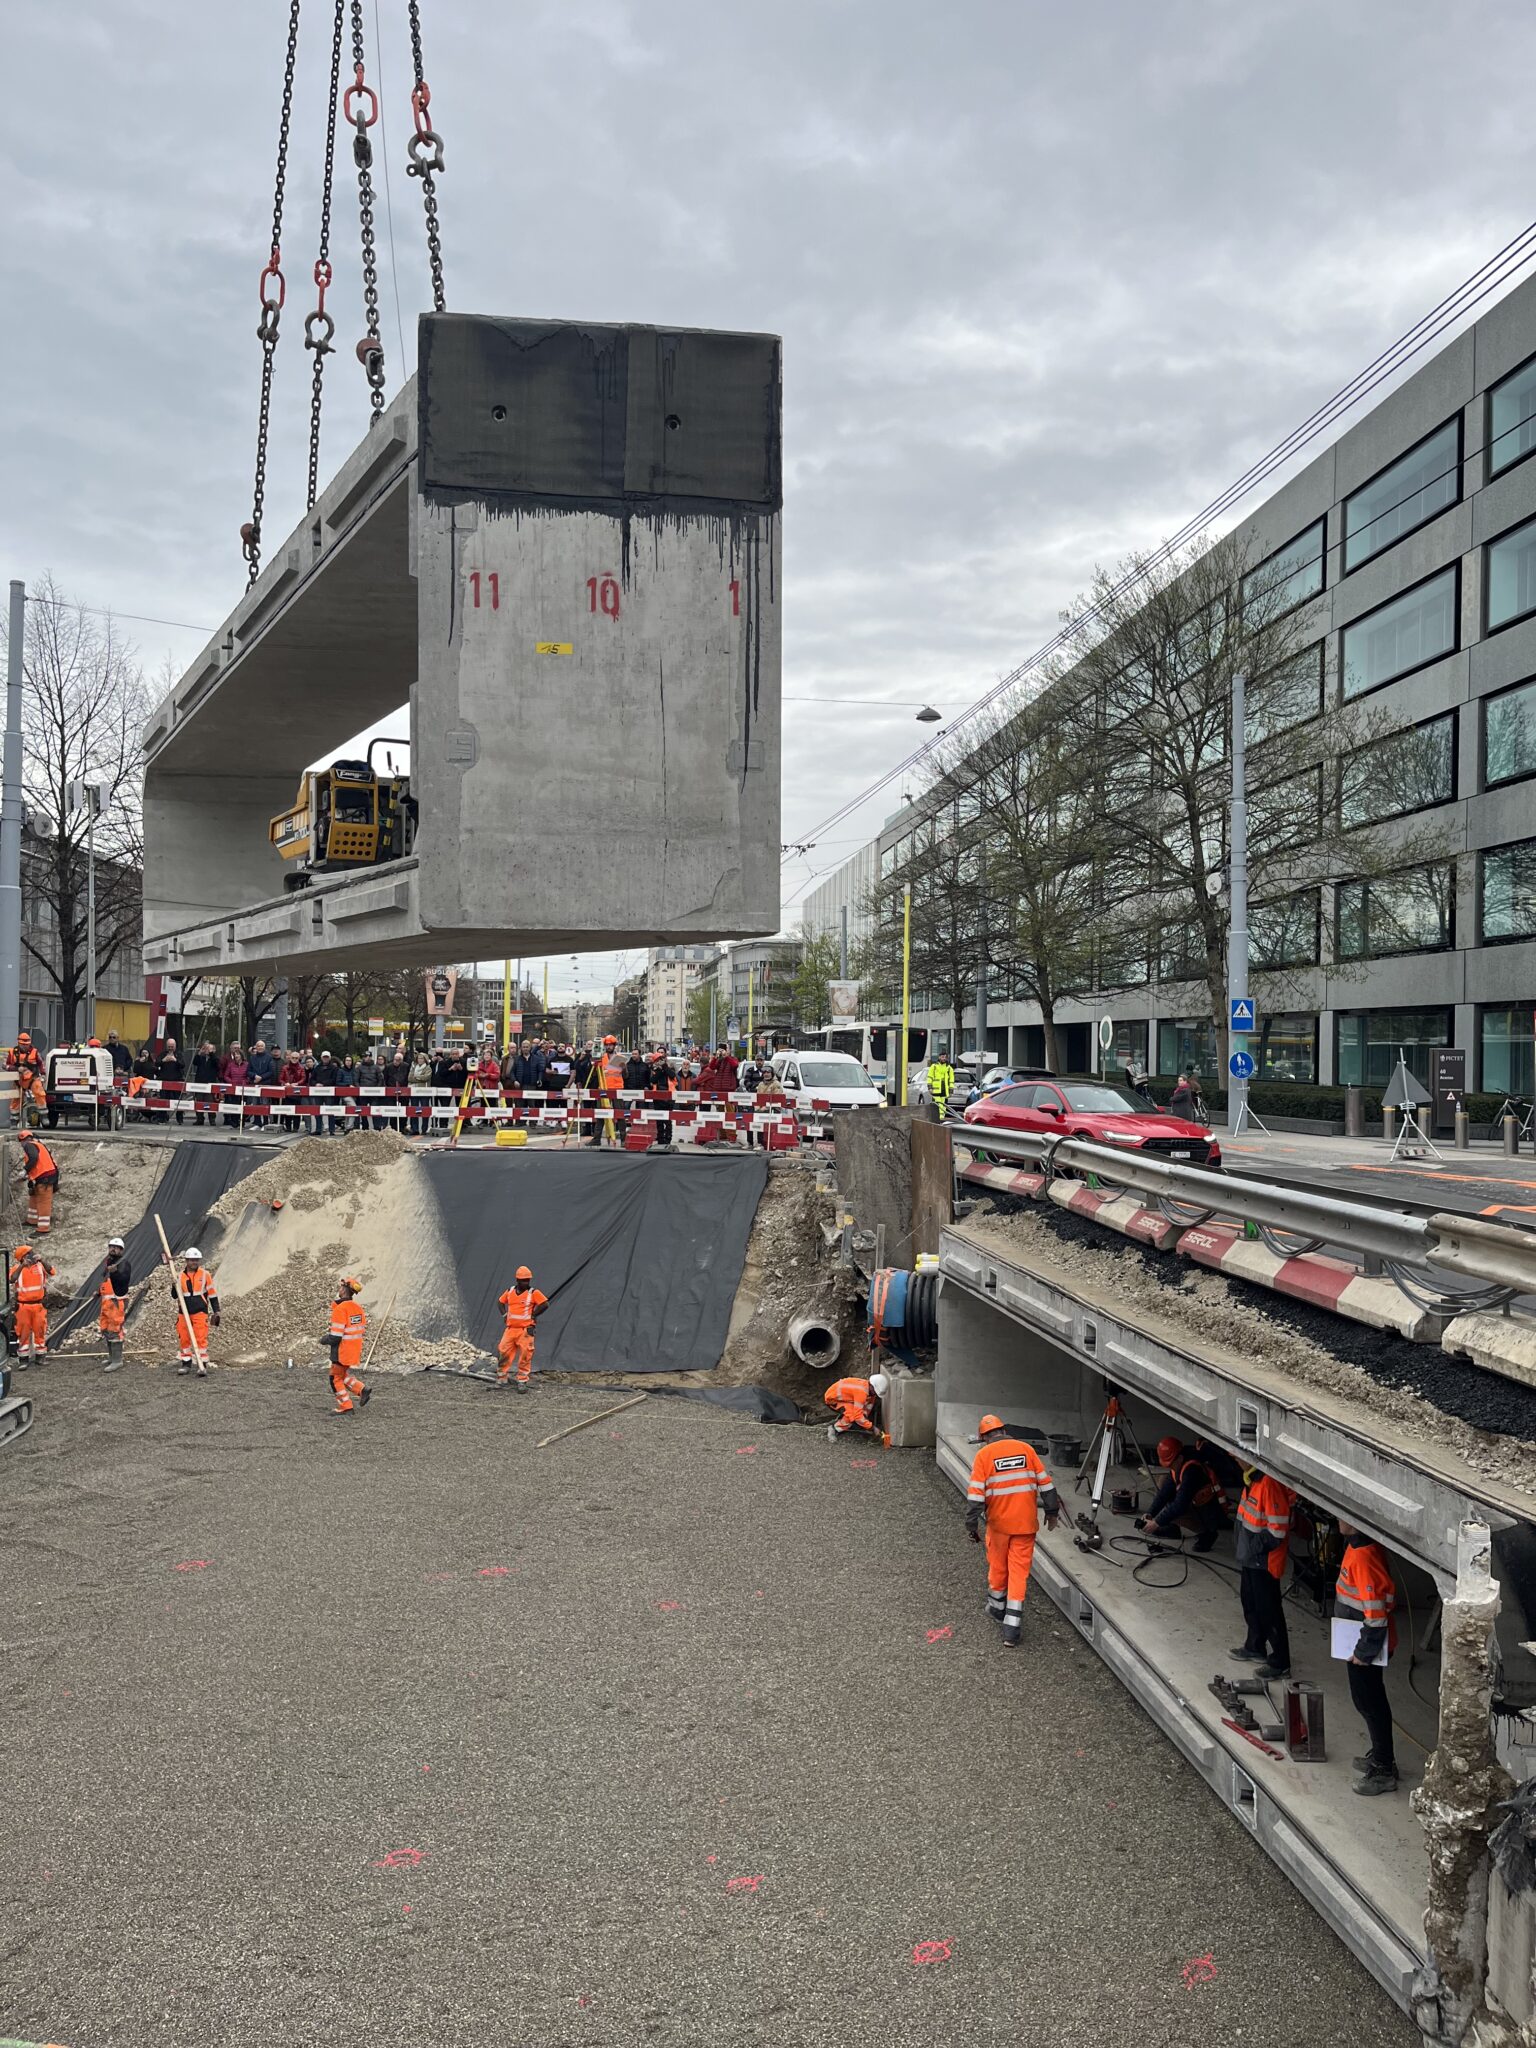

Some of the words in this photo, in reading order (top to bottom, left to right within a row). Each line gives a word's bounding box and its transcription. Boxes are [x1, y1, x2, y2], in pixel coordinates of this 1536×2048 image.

[469, 572, 499, 611] 11
[586, 575, 620, 616] 10
[728, 580, 739, 616] 1
[1185, 1231, 1218, 1249] SEROC
